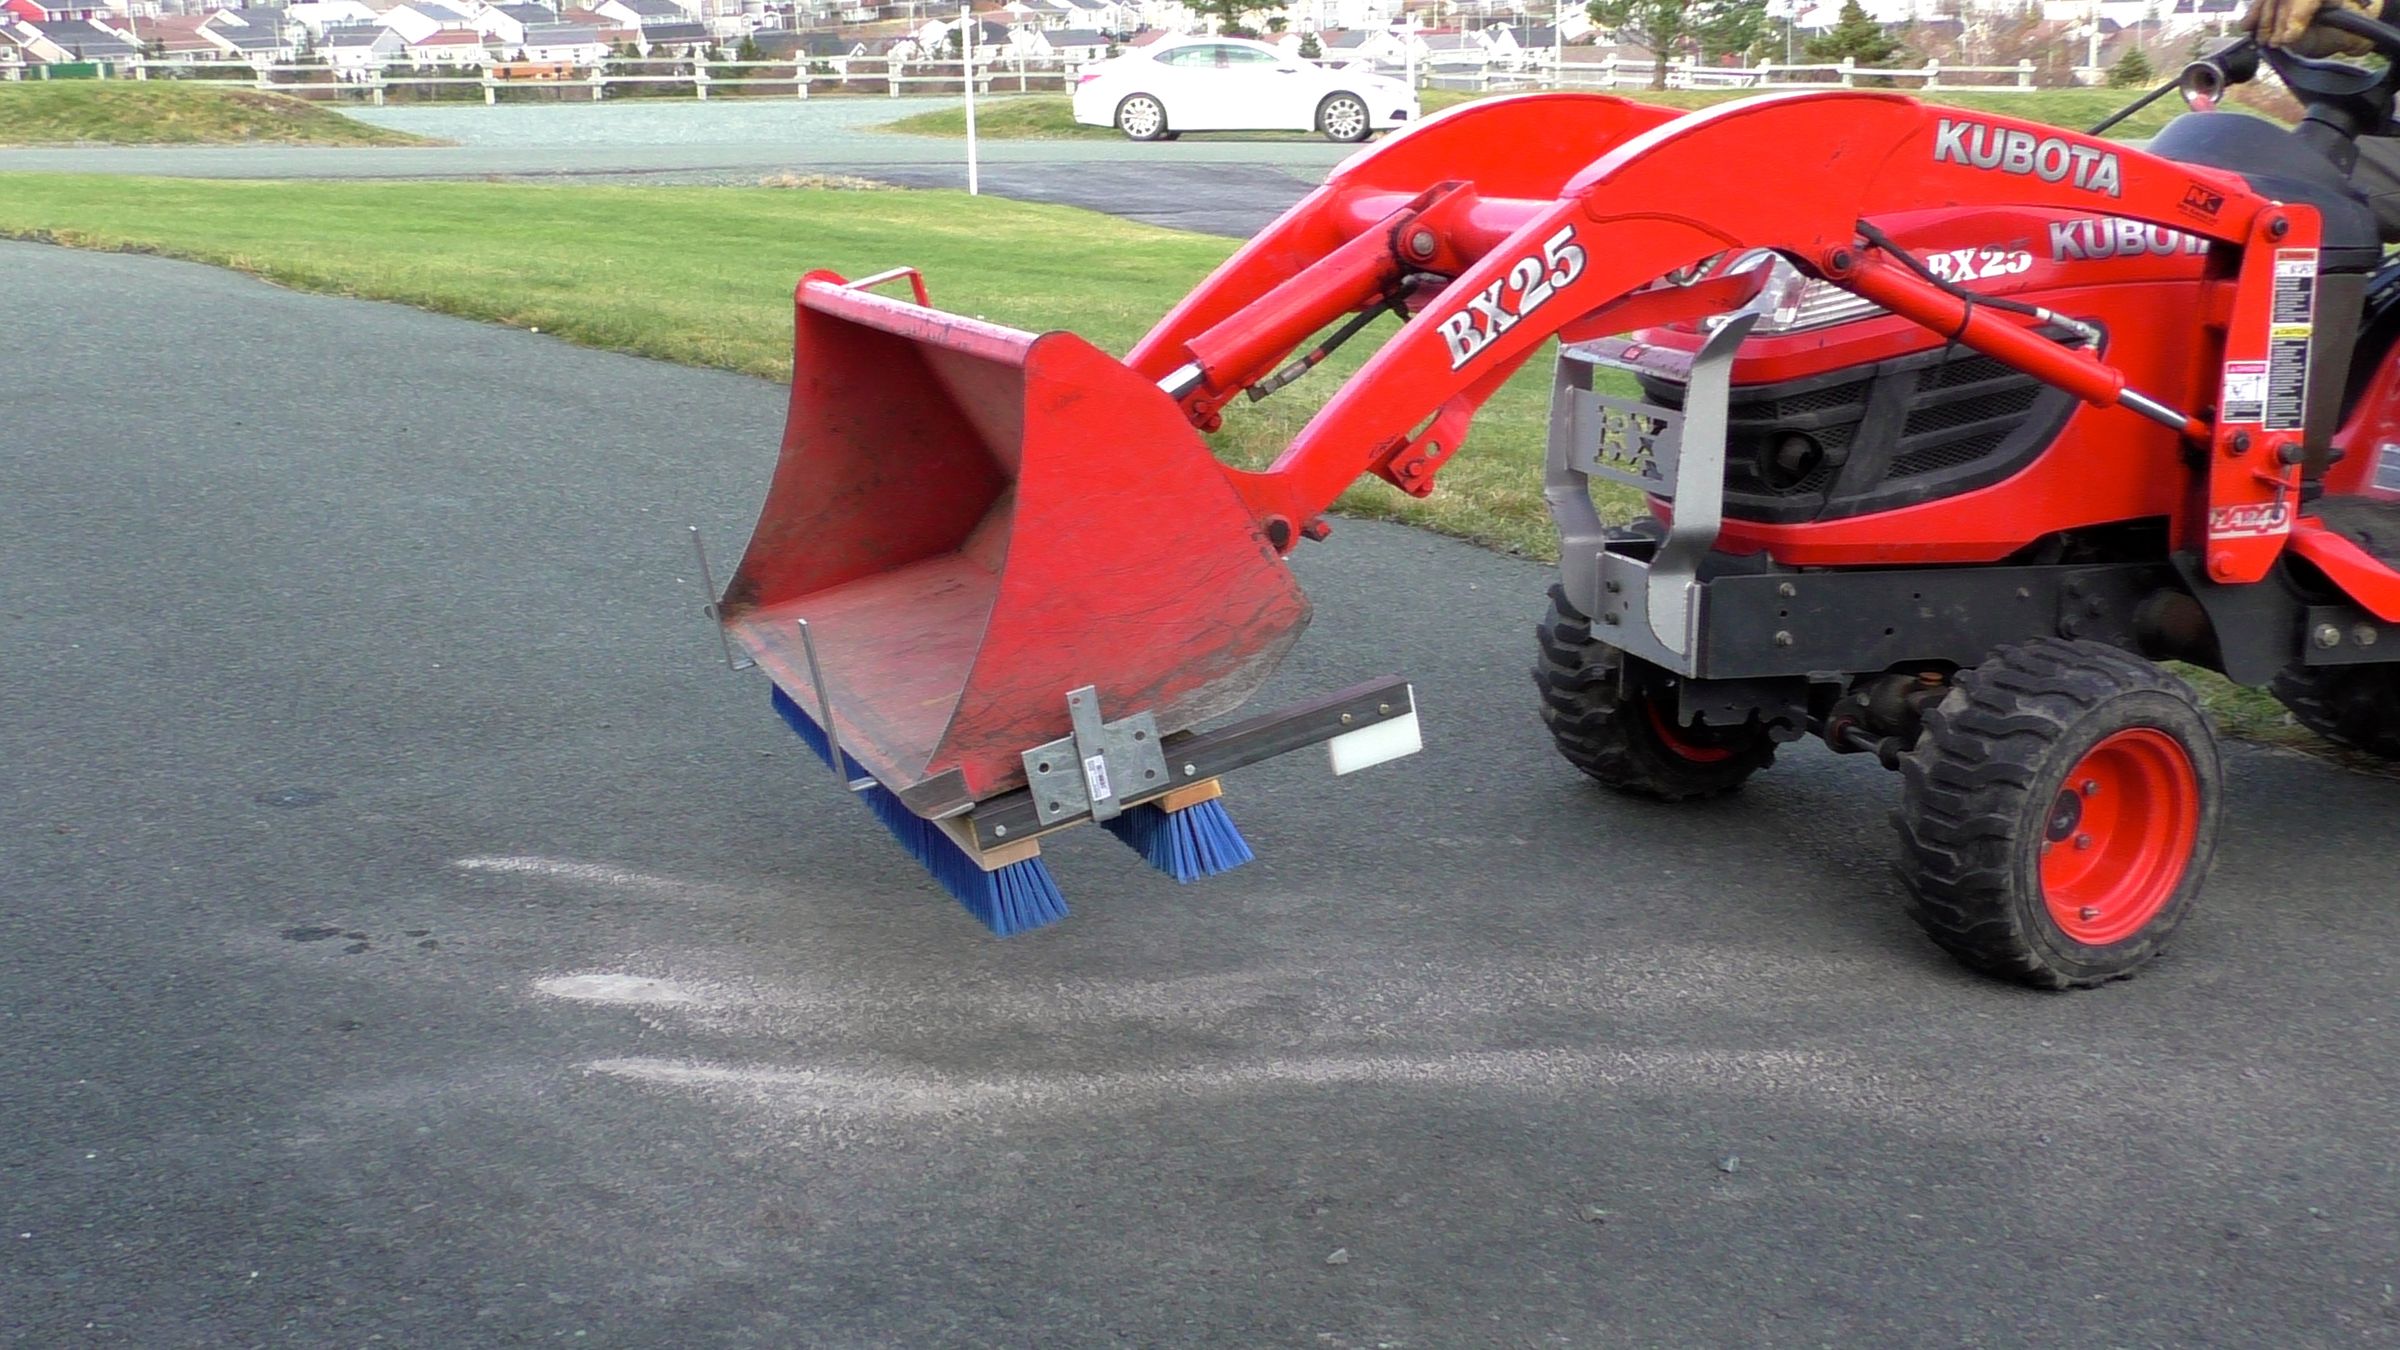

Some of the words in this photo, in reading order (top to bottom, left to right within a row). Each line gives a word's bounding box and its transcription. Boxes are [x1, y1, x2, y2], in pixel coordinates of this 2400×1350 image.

[1934, 118, 2121, 198] KUBOTA
[1926, 238, 2033, 284] BX25
[2050, 217, 2210, 261] KUBO
[1437, 224, 1586, 371] BX25
